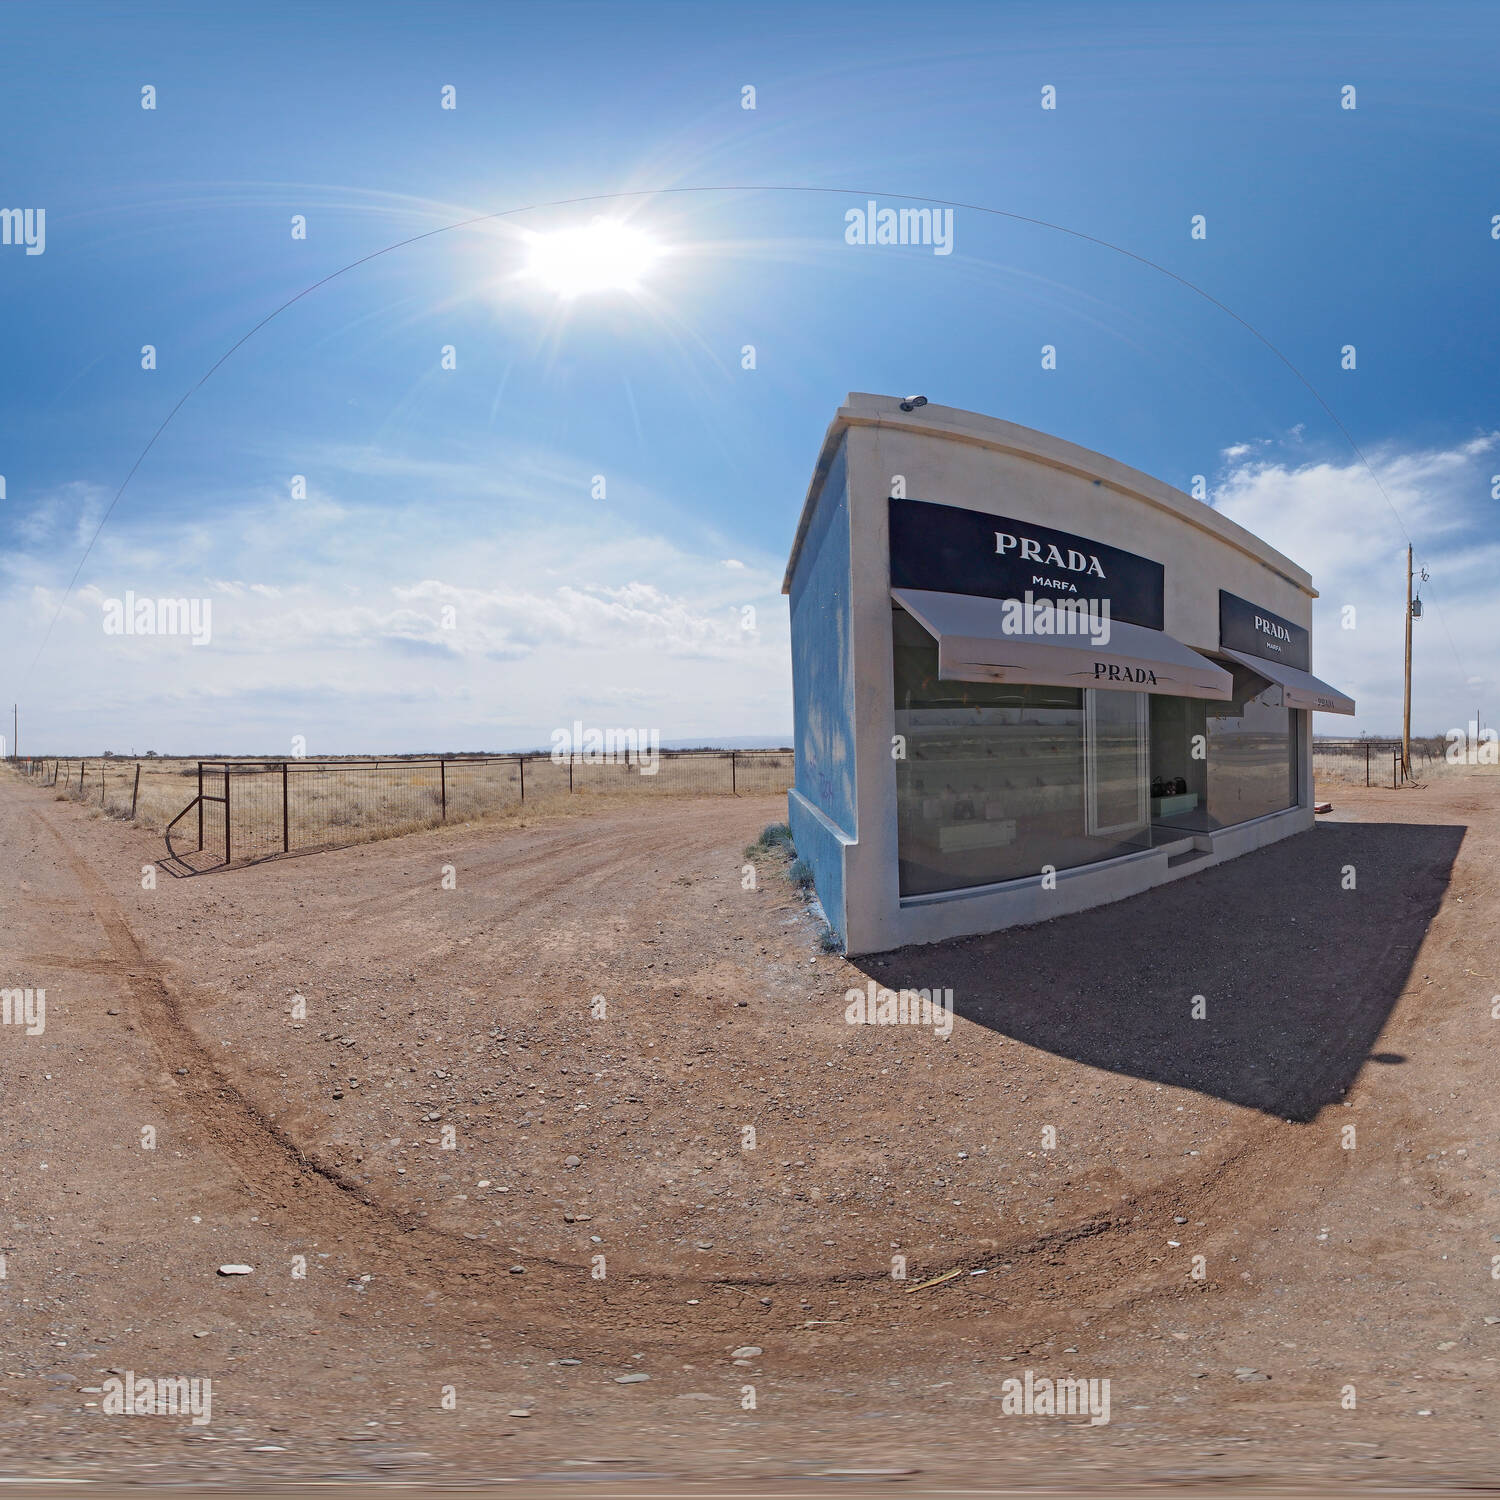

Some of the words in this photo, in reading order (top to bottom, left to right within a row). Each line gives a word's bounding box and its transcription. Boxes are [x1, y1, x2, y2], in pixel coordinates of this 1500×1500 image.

[994, 531, 1106, 579] PRADA
[1032, 575, 1077, 593] MARFA
[1255, 615, 1291, 643] PRADA
[1266, 641, 1282, 653] MARFA
[1094, 662, 1157, 685] PRADA
